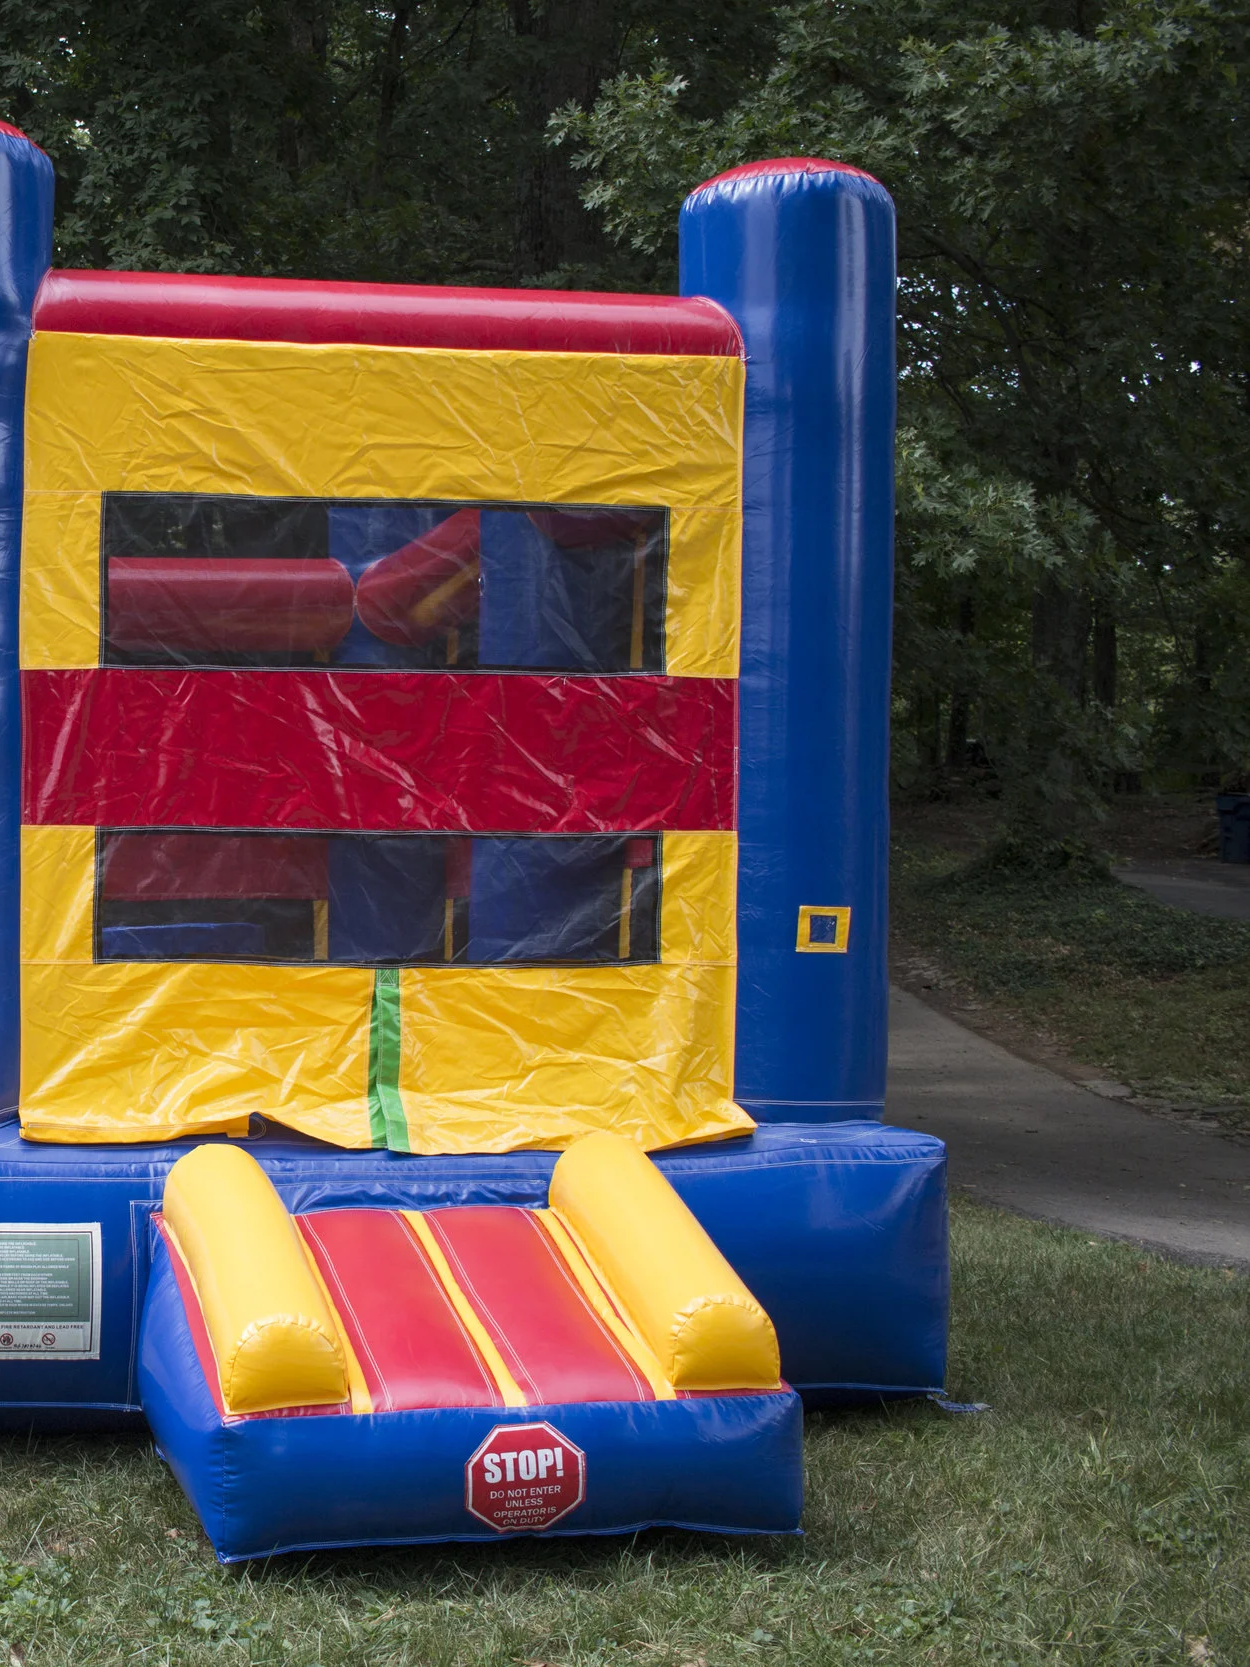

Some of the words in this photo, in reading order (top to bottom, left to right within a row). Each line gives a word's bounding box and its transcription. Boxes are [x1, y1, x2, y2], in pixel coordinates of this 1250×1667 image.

[483, 1447, 564, 1484] STOP!
[490, 1490, 504, 1499] DO
[507, 1488, 527, 1498] NOT
[530, 1485, 561, 1496] ENTER
[505, 1498, 543, 1508] UNLESS
[494, 1507, 546, 1518] OPERATOR
[519, 1516, 545, 1524] DUTY
